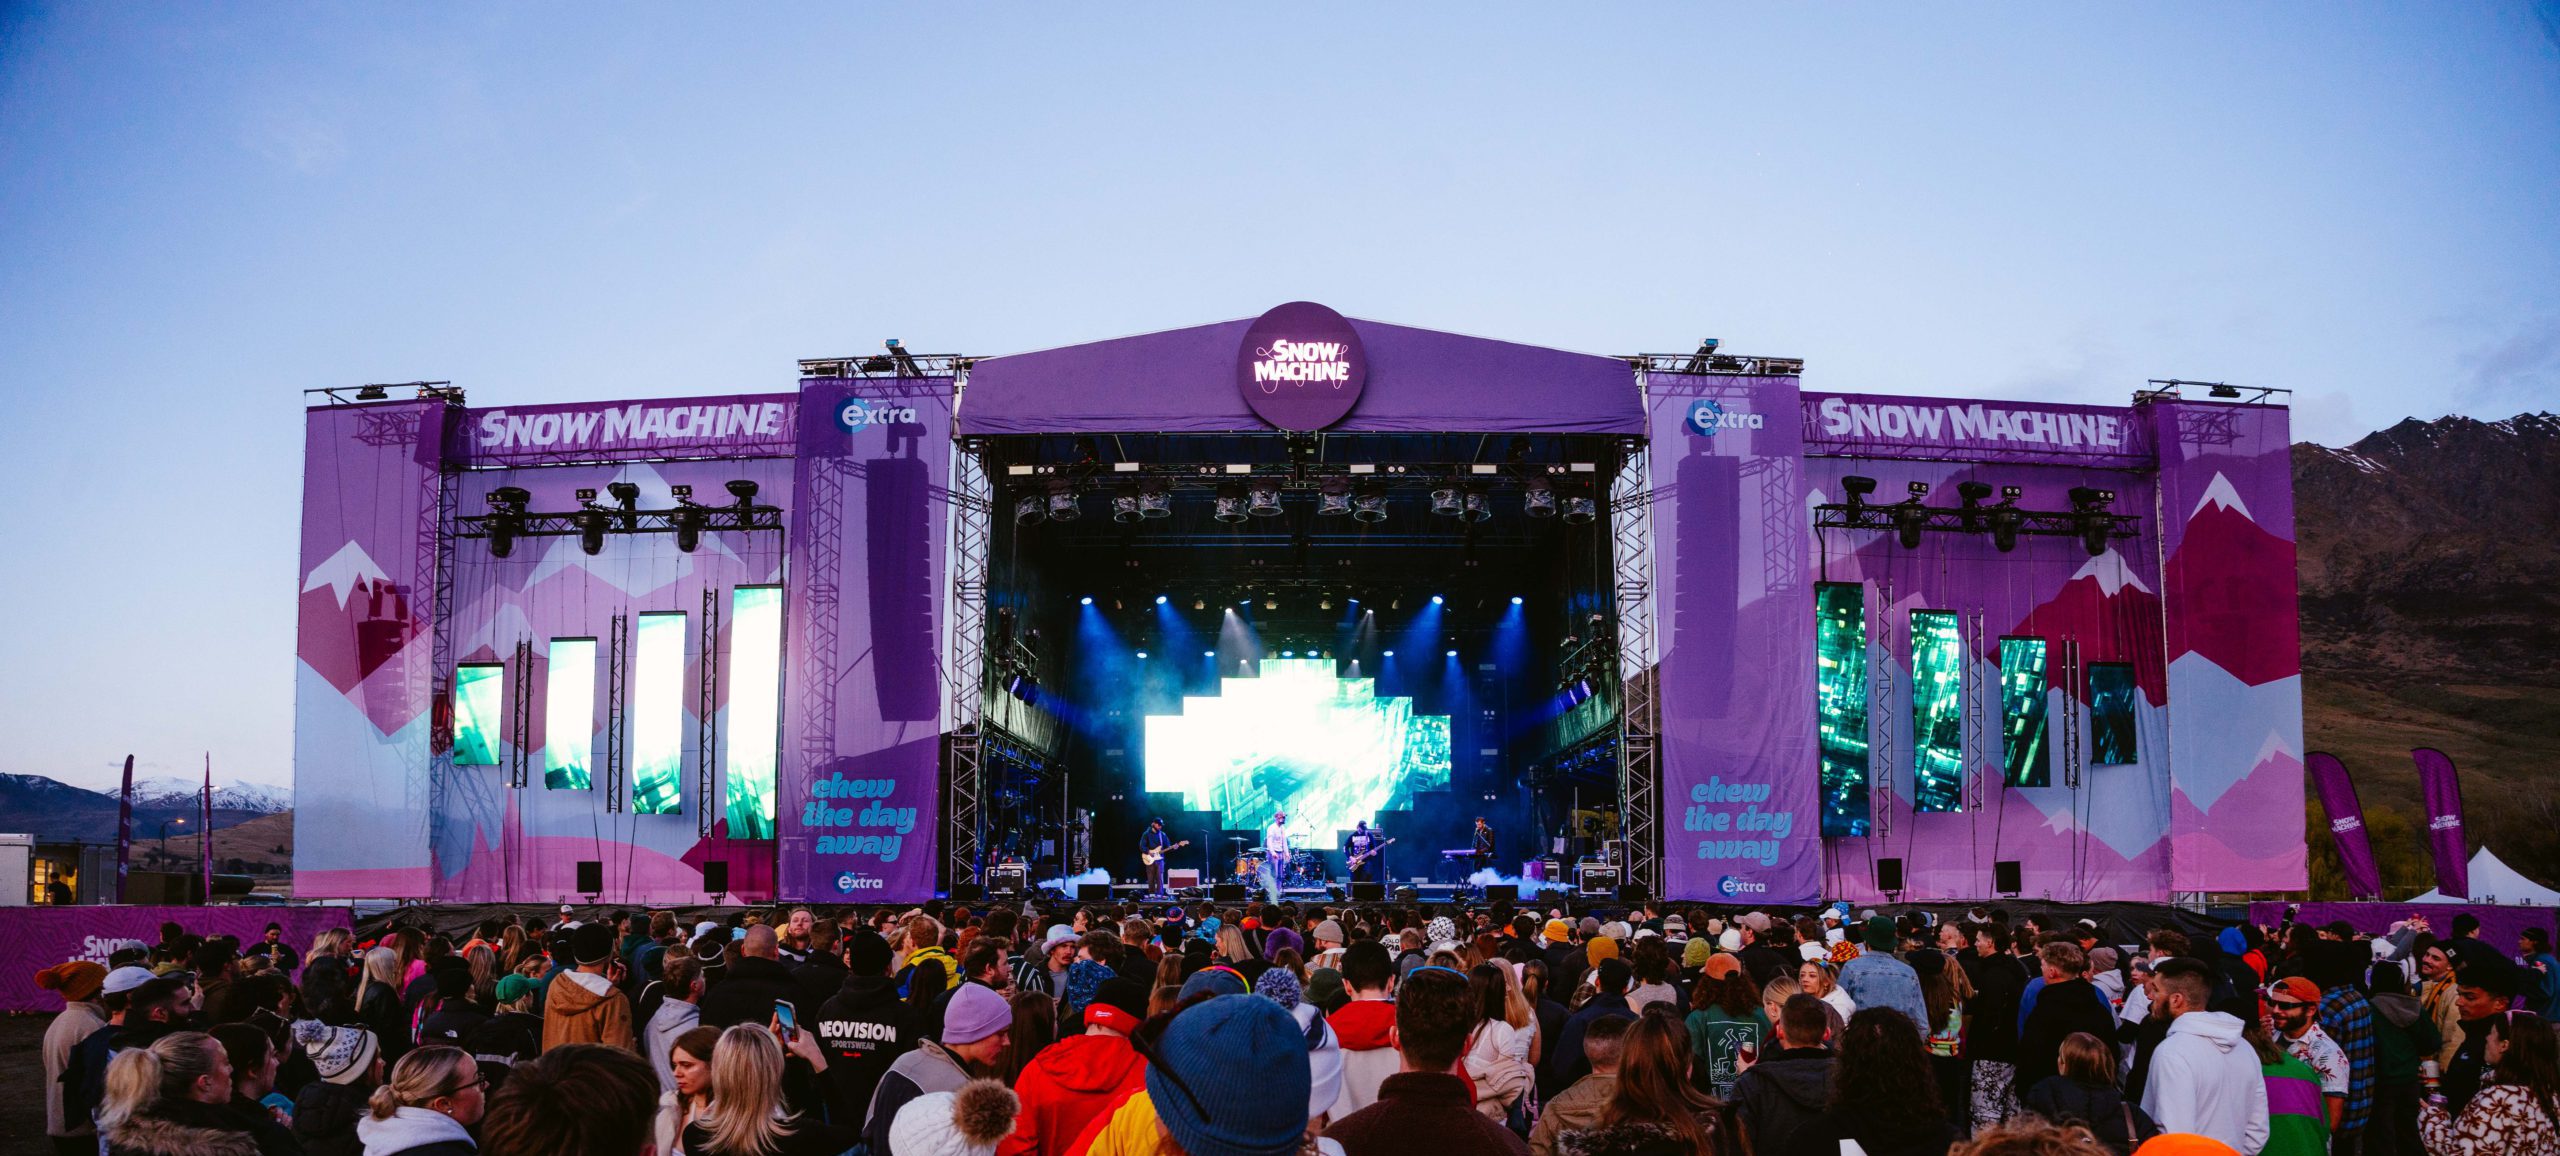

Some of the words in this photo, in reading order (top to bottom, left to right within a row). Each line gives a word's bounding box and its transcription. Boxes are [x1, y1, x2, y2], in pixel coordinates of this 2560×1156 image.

[1272, 339, 1340, 361] SNOW
[1254, 360, 1350, 382] MACHINE
[481, 410, 600, 447] SNOW
[603, 402, 784, 442] MACHINE
[842, 405, 916, 426] extra
[1694, 407, 1763, 429] extra
[1820, 397, 1943, 440] SNOW
[1948, 404, 2121, 447] MACHINE
[811, 772, 895, 798] chew
[1691, 776, 1771, 803] chew
[802, 800, 853, 827] the
[859, 800, 917, 834] day
[1684, 805, 1731, 832] the
[1736, 805, 1793, 839] day
[816, 835, 902, 862] away
[1697, 840, 1780, 867] away
[838, 876, 883, 889] extra
[1722, 880, 1766, 892] extra
[84, 935, 142, 957] SNO
[819, 1020, 897, 1043] NEOVISION
[831, 1040, 876, 1050] SPORTSWEAR
